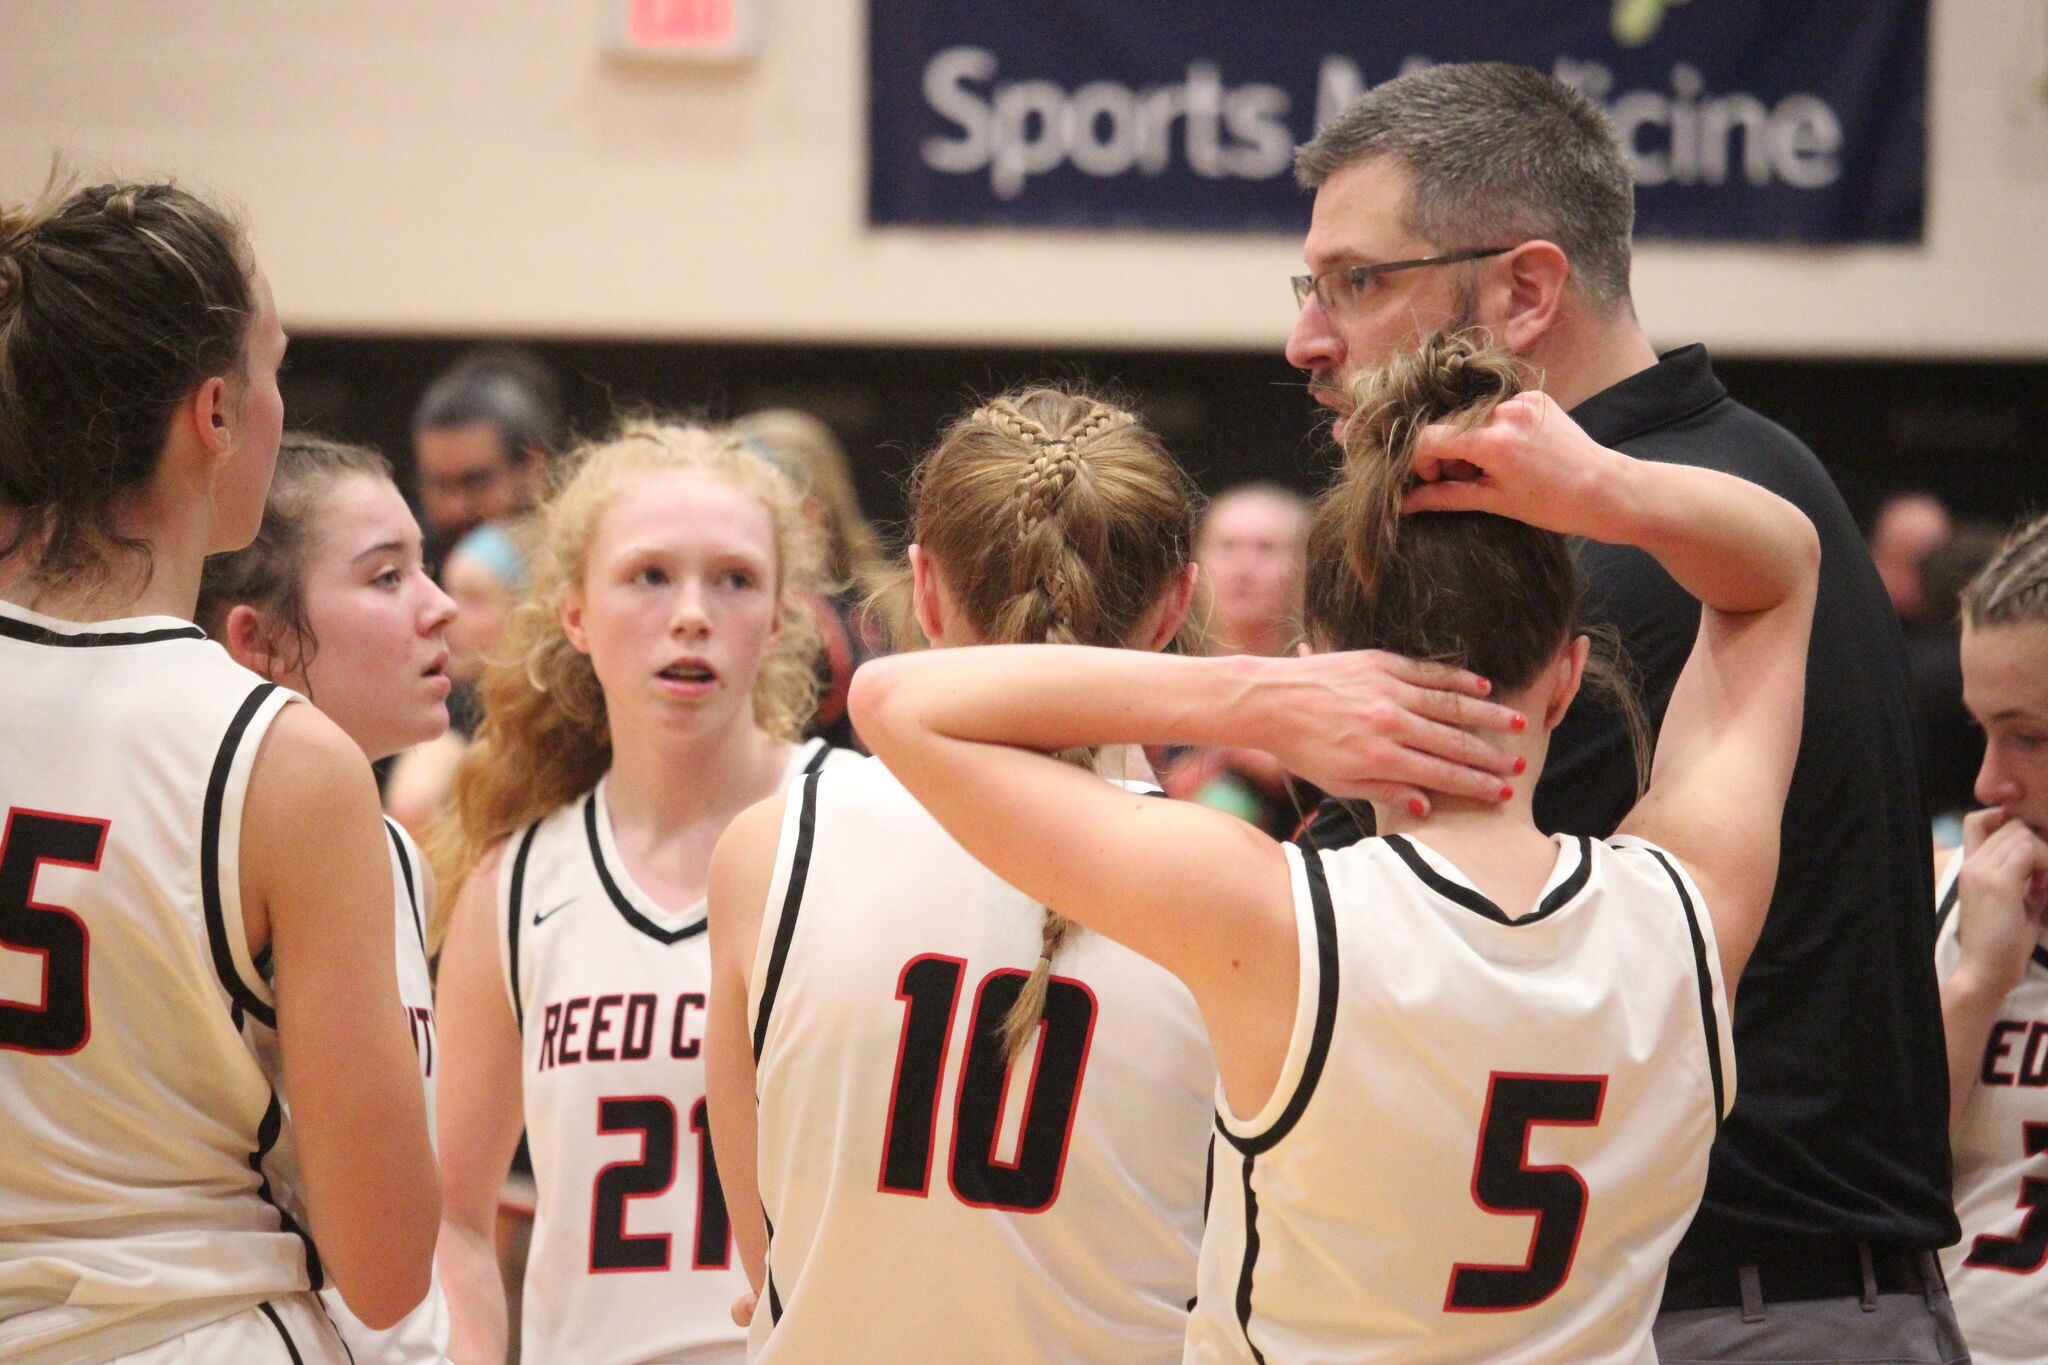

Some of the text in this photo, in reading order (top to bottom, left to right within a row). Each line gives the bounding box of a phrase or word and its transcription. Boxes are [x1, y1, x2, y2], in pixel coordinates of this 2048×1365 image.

[921, 46, 1843, 197] Sports cine
[0, 806, 111, 1056] 5
[539, 993, 657, 1072] REED
[588, 1095, 732, 1275] 21
[877, 952, 1098, 1215] 10
[1443, 1071, 1609, 1312] 5
